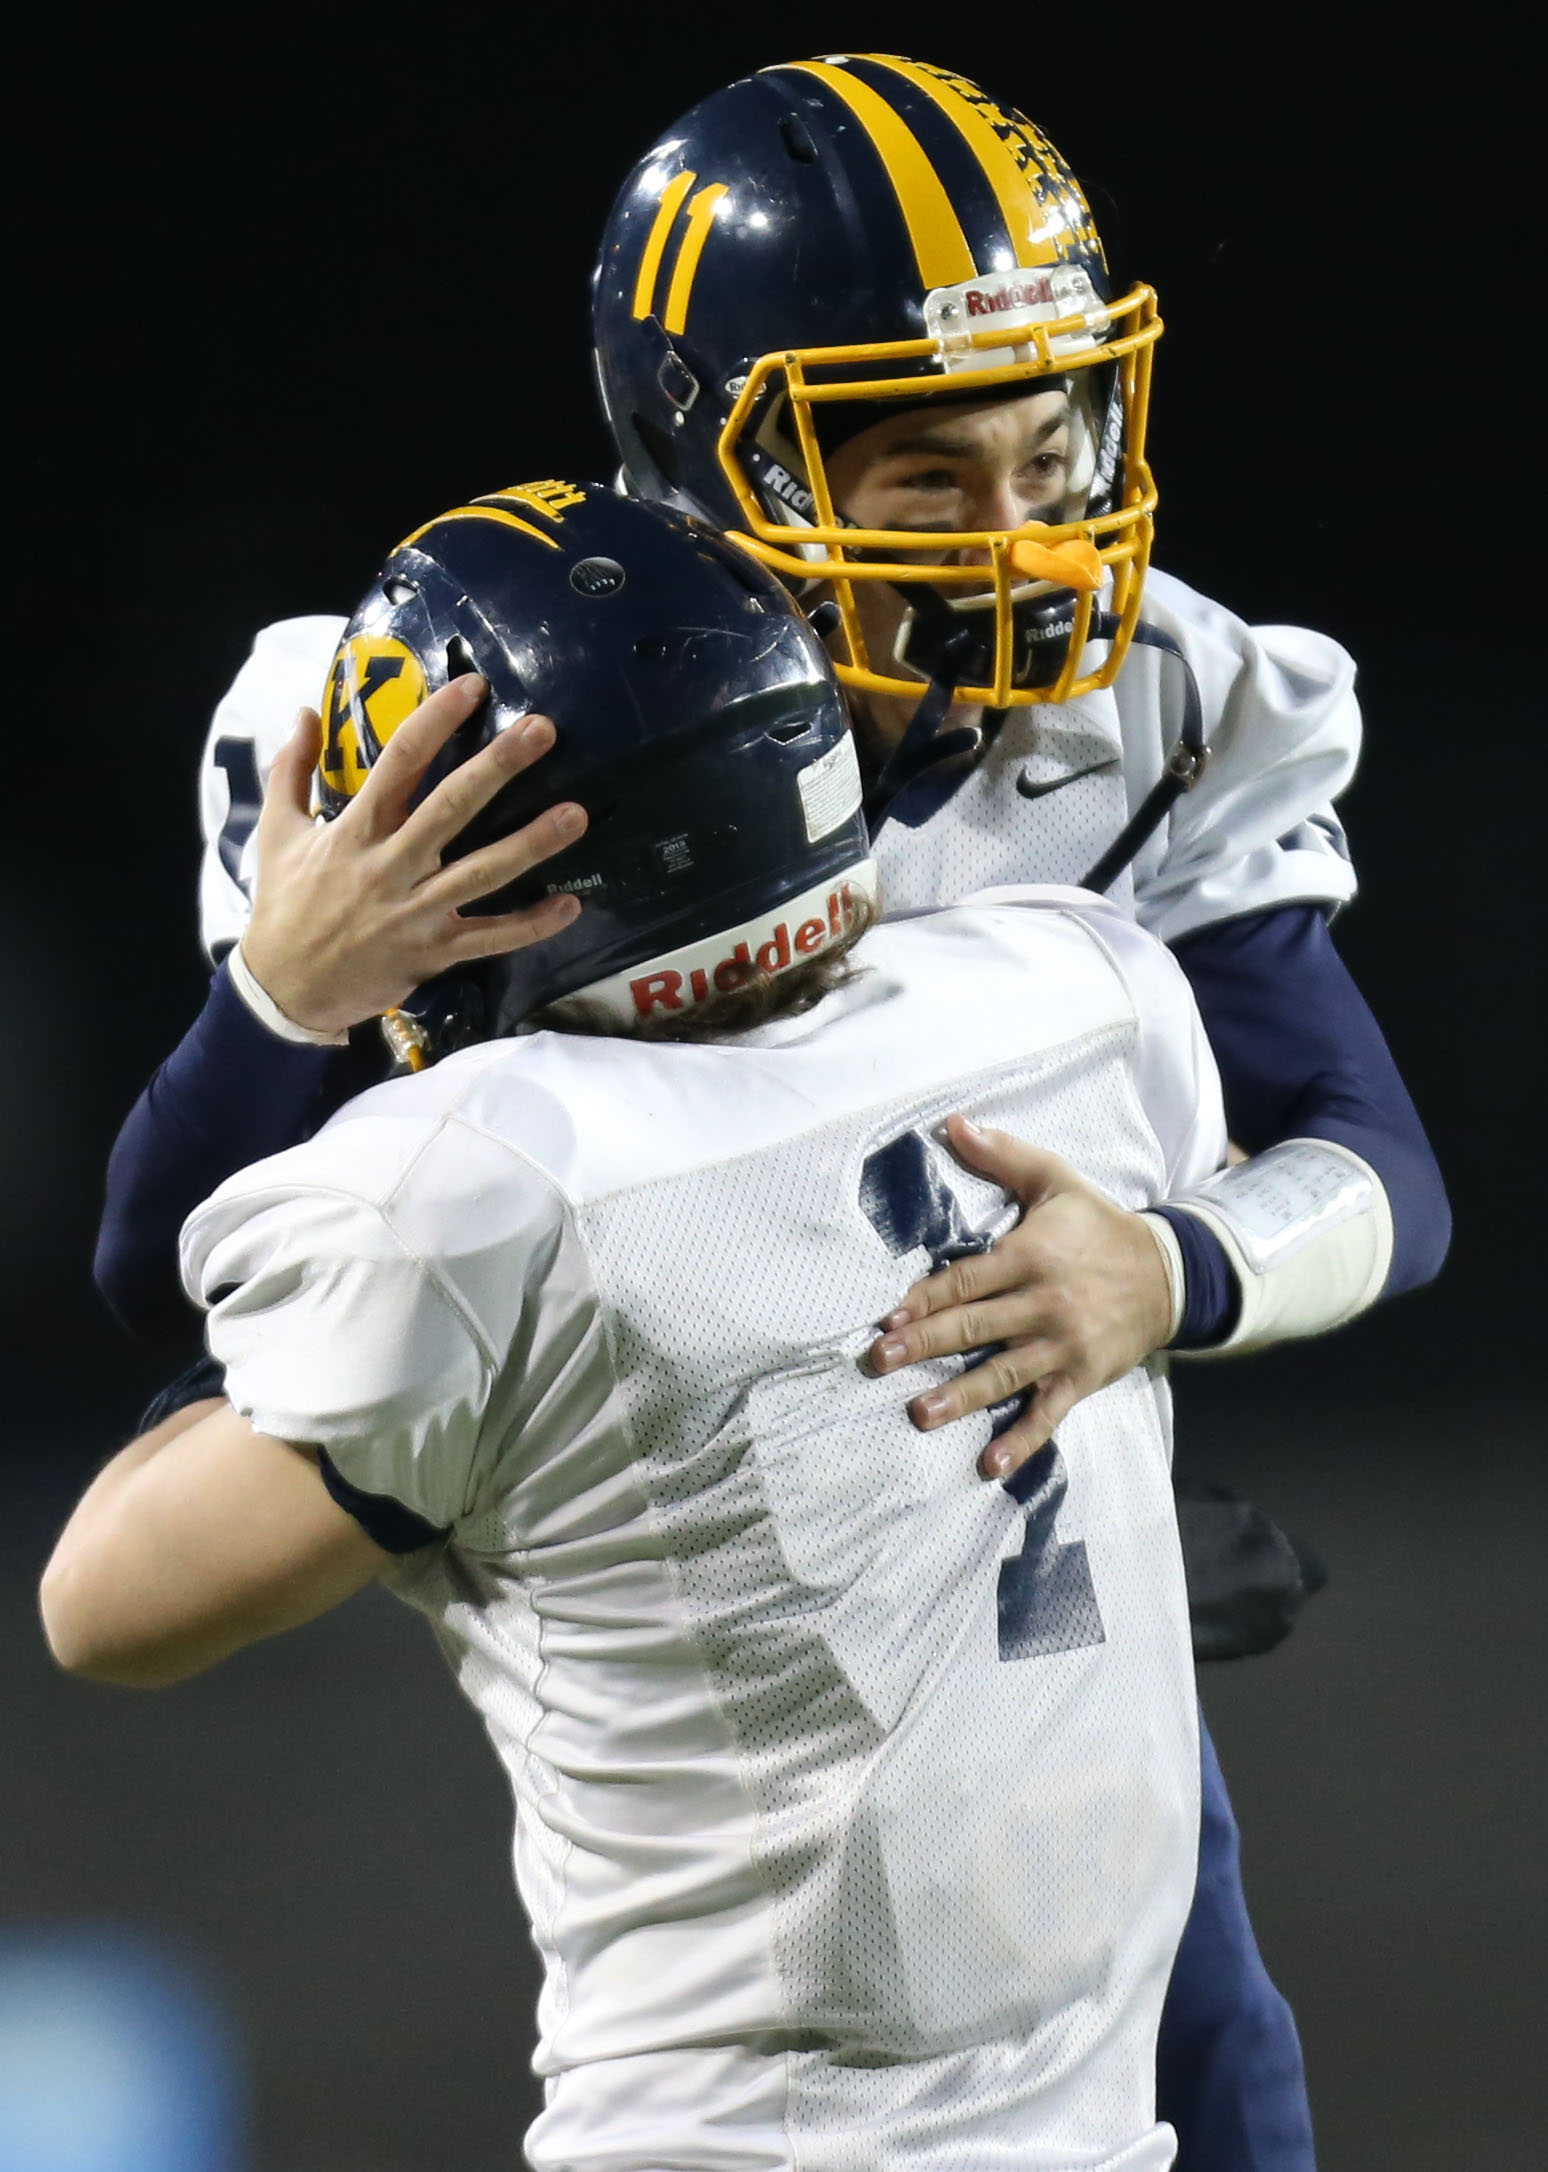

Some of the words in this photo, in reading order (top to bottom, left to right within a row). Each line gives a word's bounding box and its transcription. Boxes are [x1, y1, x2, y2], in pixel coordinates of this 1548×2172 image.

[632, 169, 731, 336] 11
[1025, 616, 1076, 643] Ridde
[324, 656, 405, 772] K
[629, 883, 852, 1018] Riddell
